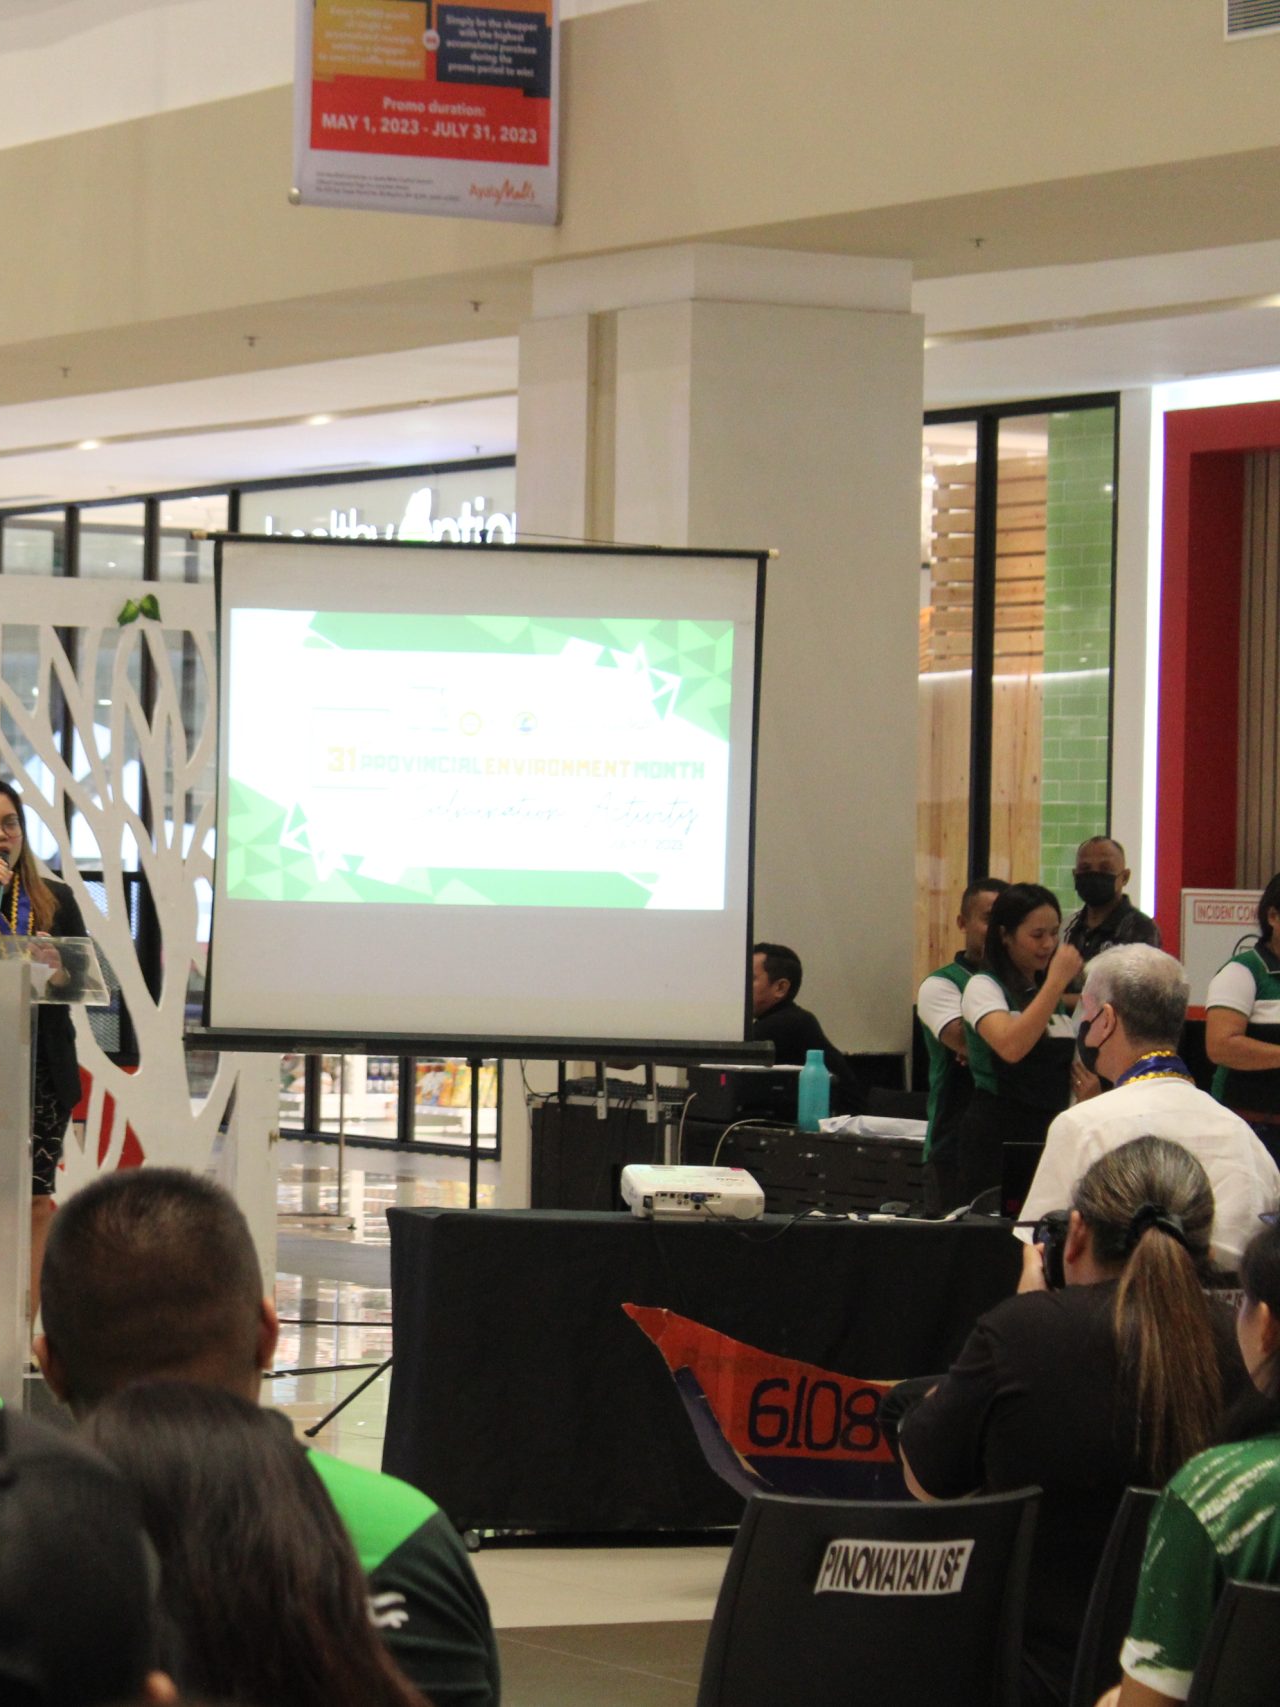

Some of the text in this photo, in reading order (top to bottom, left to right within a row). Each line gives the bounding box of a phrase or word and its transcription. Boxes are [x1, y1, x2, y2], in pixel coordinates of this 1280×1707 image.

[383, 96, 487, 118] Promo duration:
[322, 113, 358, 131] MAY
[363, 116, 376, 135] 1,
[381, 117, 419, 135] 2023
[432, 120, 468, 138] JULY
[473, 124, 496, 142] 31,
[500, 126, 538, 144] 2023
[1197, 904, 1235, 920] INCIDENT
[748, 1376, 882, 1451] 6108
[821, 1545, 966, 1591] PINOWAYAN ISF
